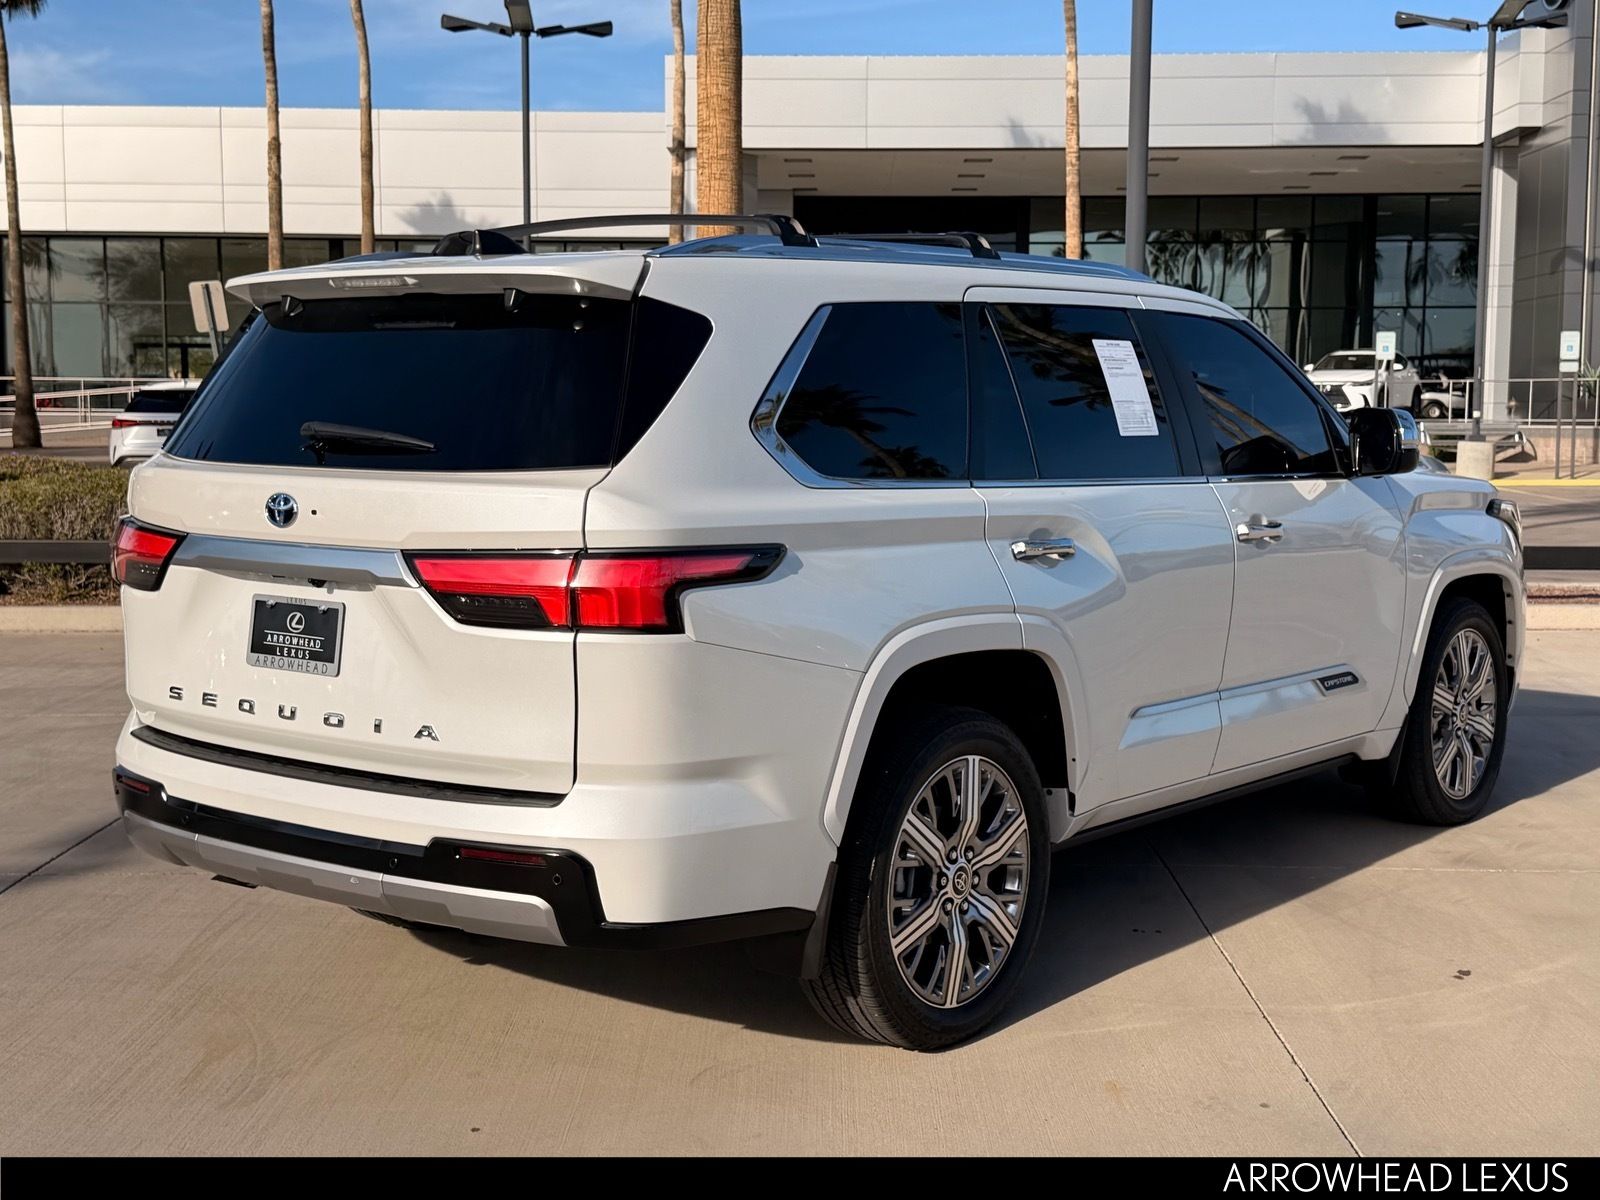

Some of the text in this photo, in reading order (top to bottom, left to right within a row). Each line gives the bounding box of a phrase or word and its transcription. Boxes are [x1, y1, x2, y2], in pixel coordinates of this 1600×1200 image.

[286, 597, 307, 605] LEXUS
[266, 633, 321, 649] ARROWHEAD
[276, 647, 310, 659] LEXUS
[254, 655, 328, 674] ARROWHEAD
[168, 686, 440, 742] SEQUOIA
